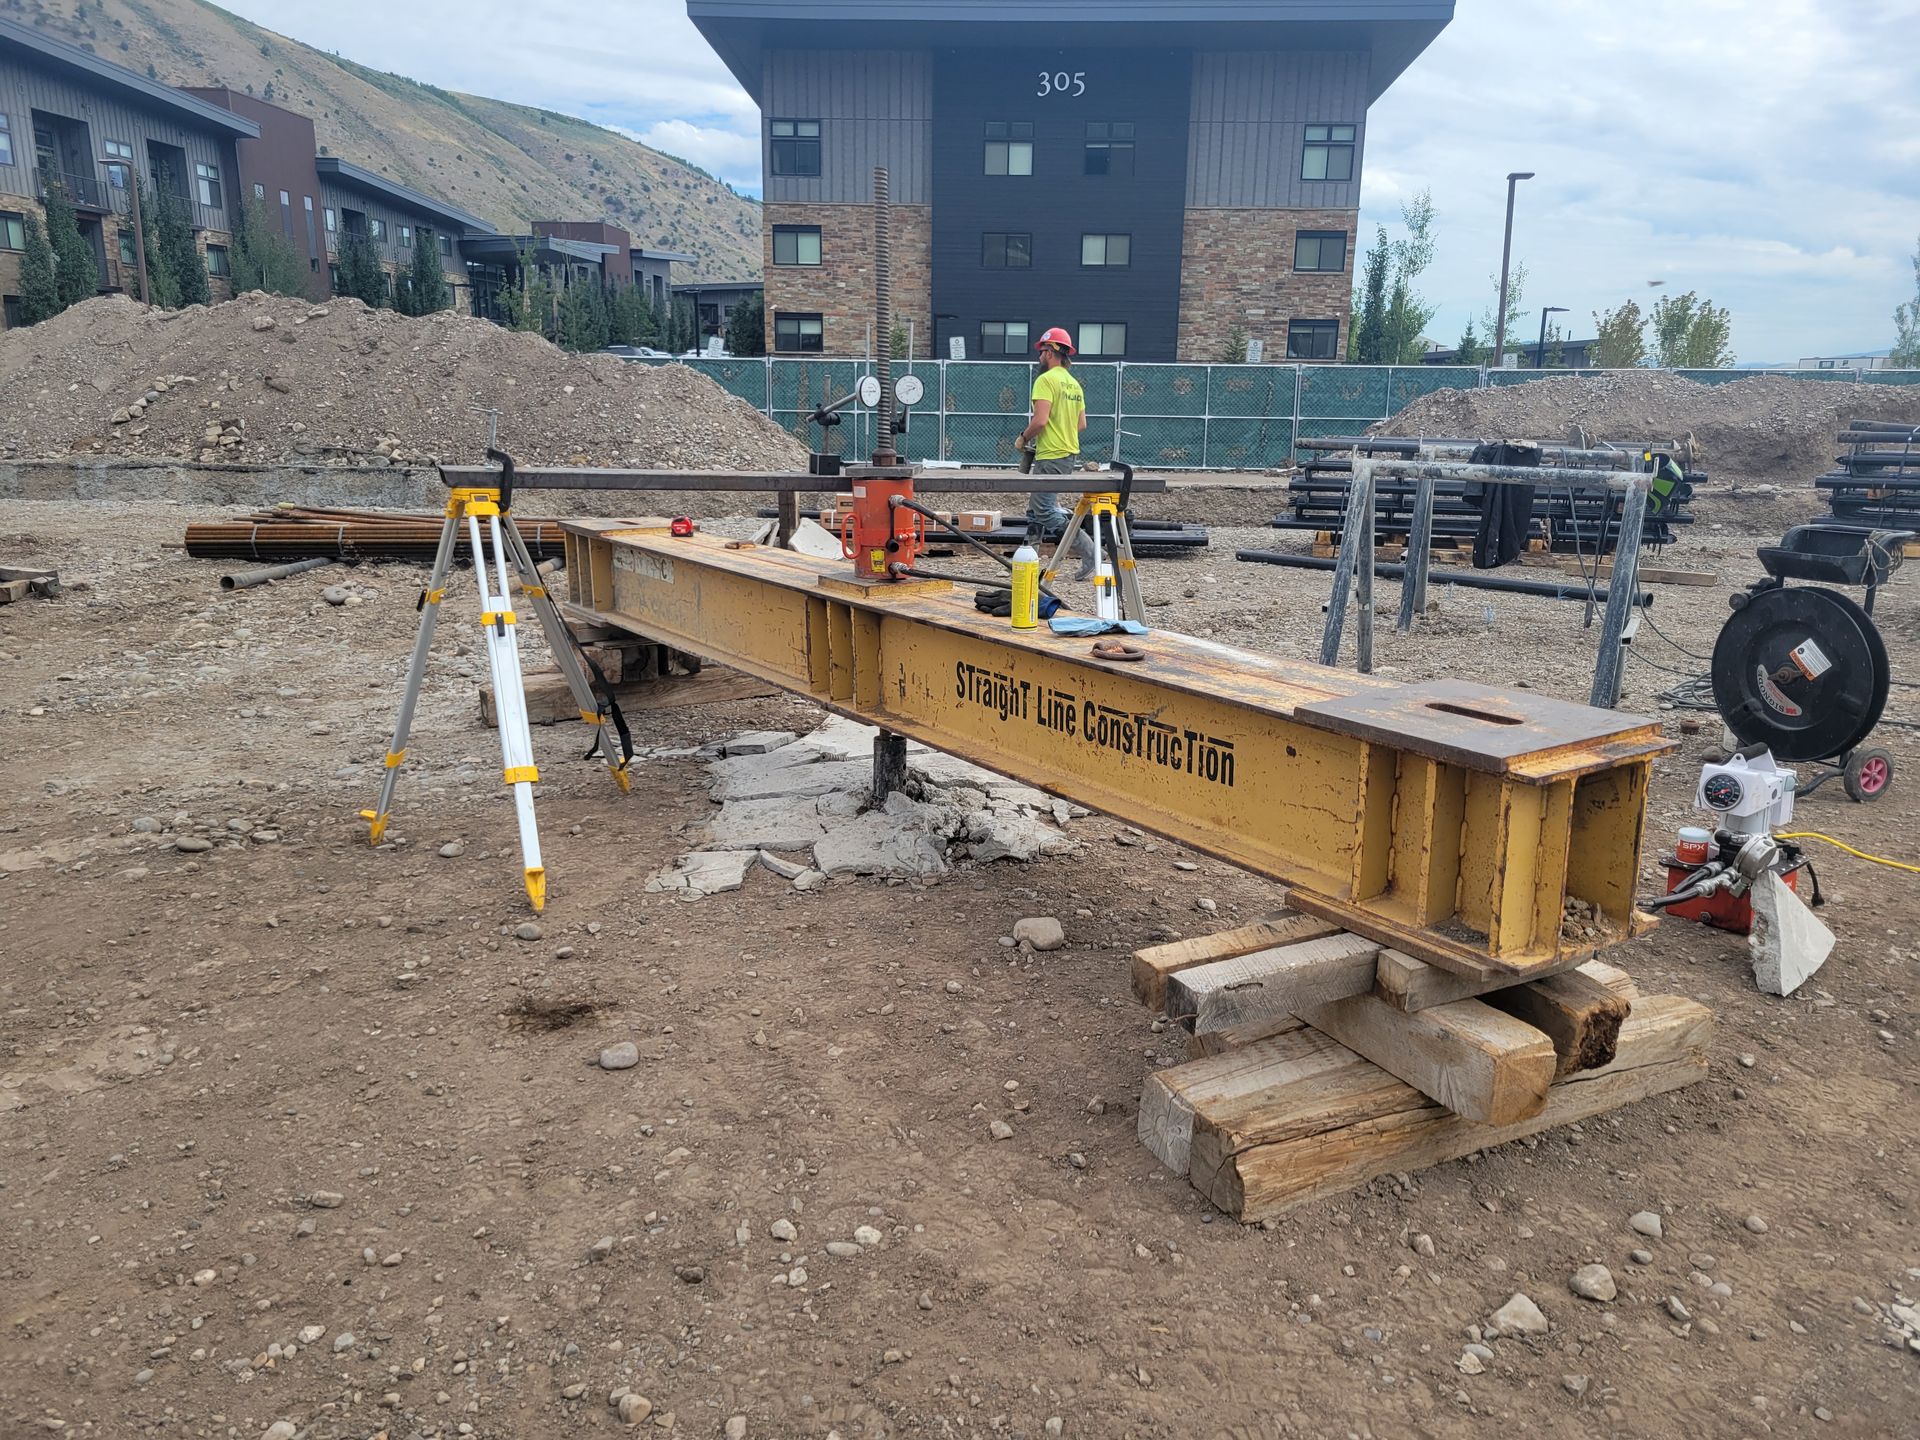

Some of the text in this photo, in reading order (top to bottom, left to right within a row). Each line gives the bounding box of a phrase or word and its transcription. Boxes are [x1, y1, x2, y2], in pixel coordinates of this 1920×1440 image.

[1037, 71, 1086, 97] 305
[1037, 685, 1076, 737] Line
[1682, 842, 1705, 851] SPX
